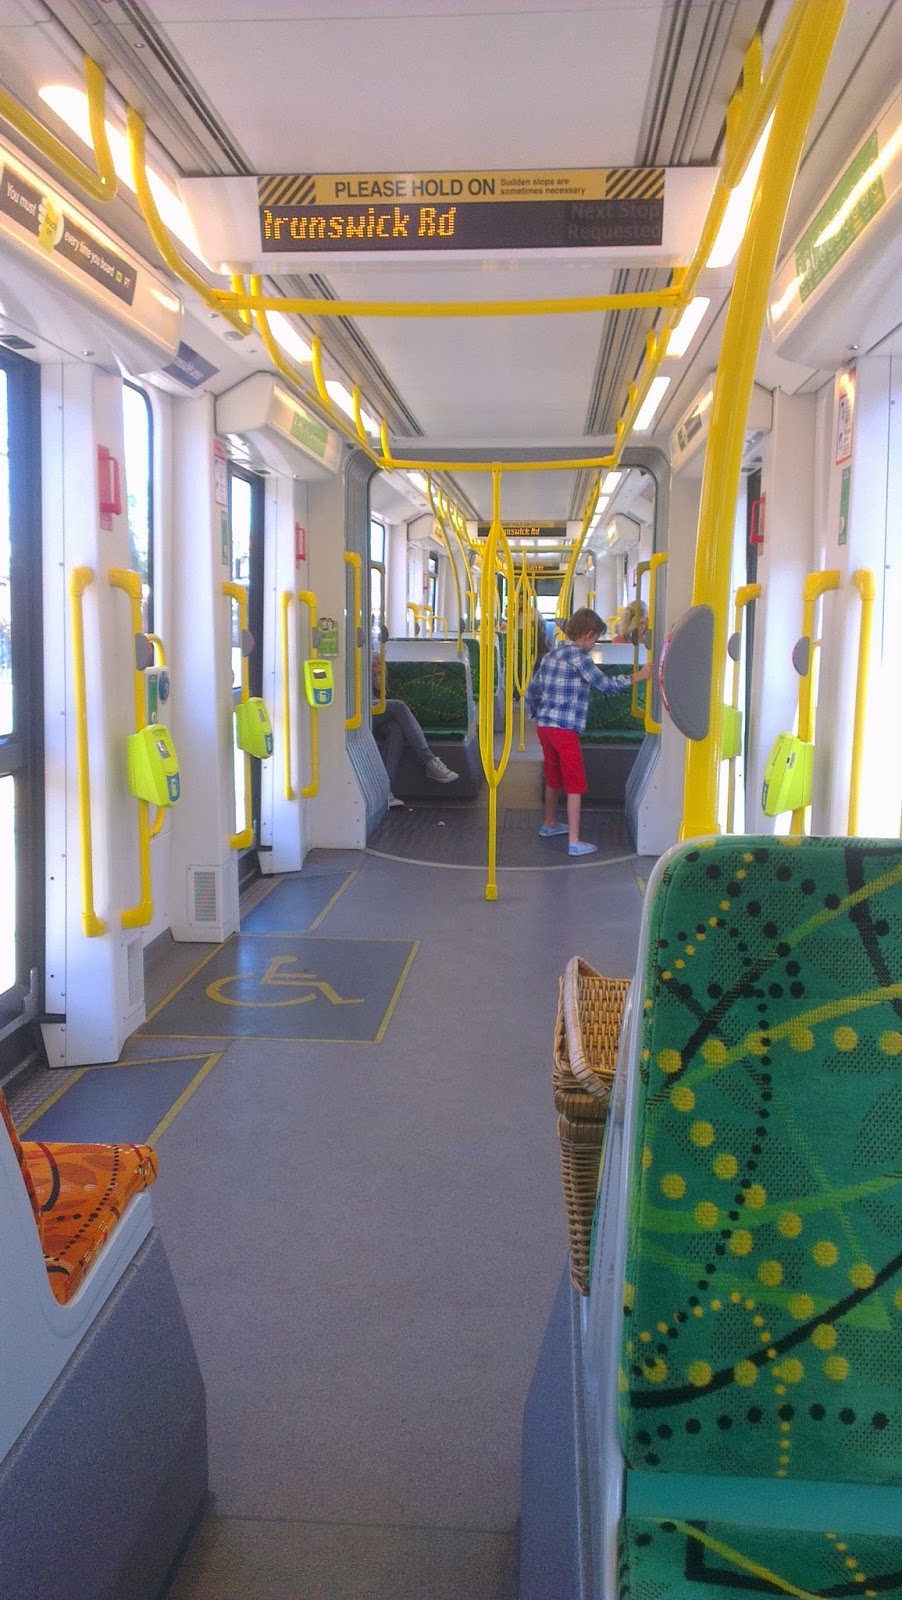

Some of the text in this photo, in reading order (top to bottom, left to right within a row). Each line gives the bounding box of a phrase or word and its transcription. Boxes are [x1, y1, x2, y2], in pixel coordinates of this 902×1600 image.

[334, 178, 496, 198] PLEASE HOLD ON
[500, 177, 570, 187] Sudden stops are
[500, 186, 586, 196] sometimes necessary
[7, 181, 37, 216] You must
[417, 206, 457, 237] Rd
